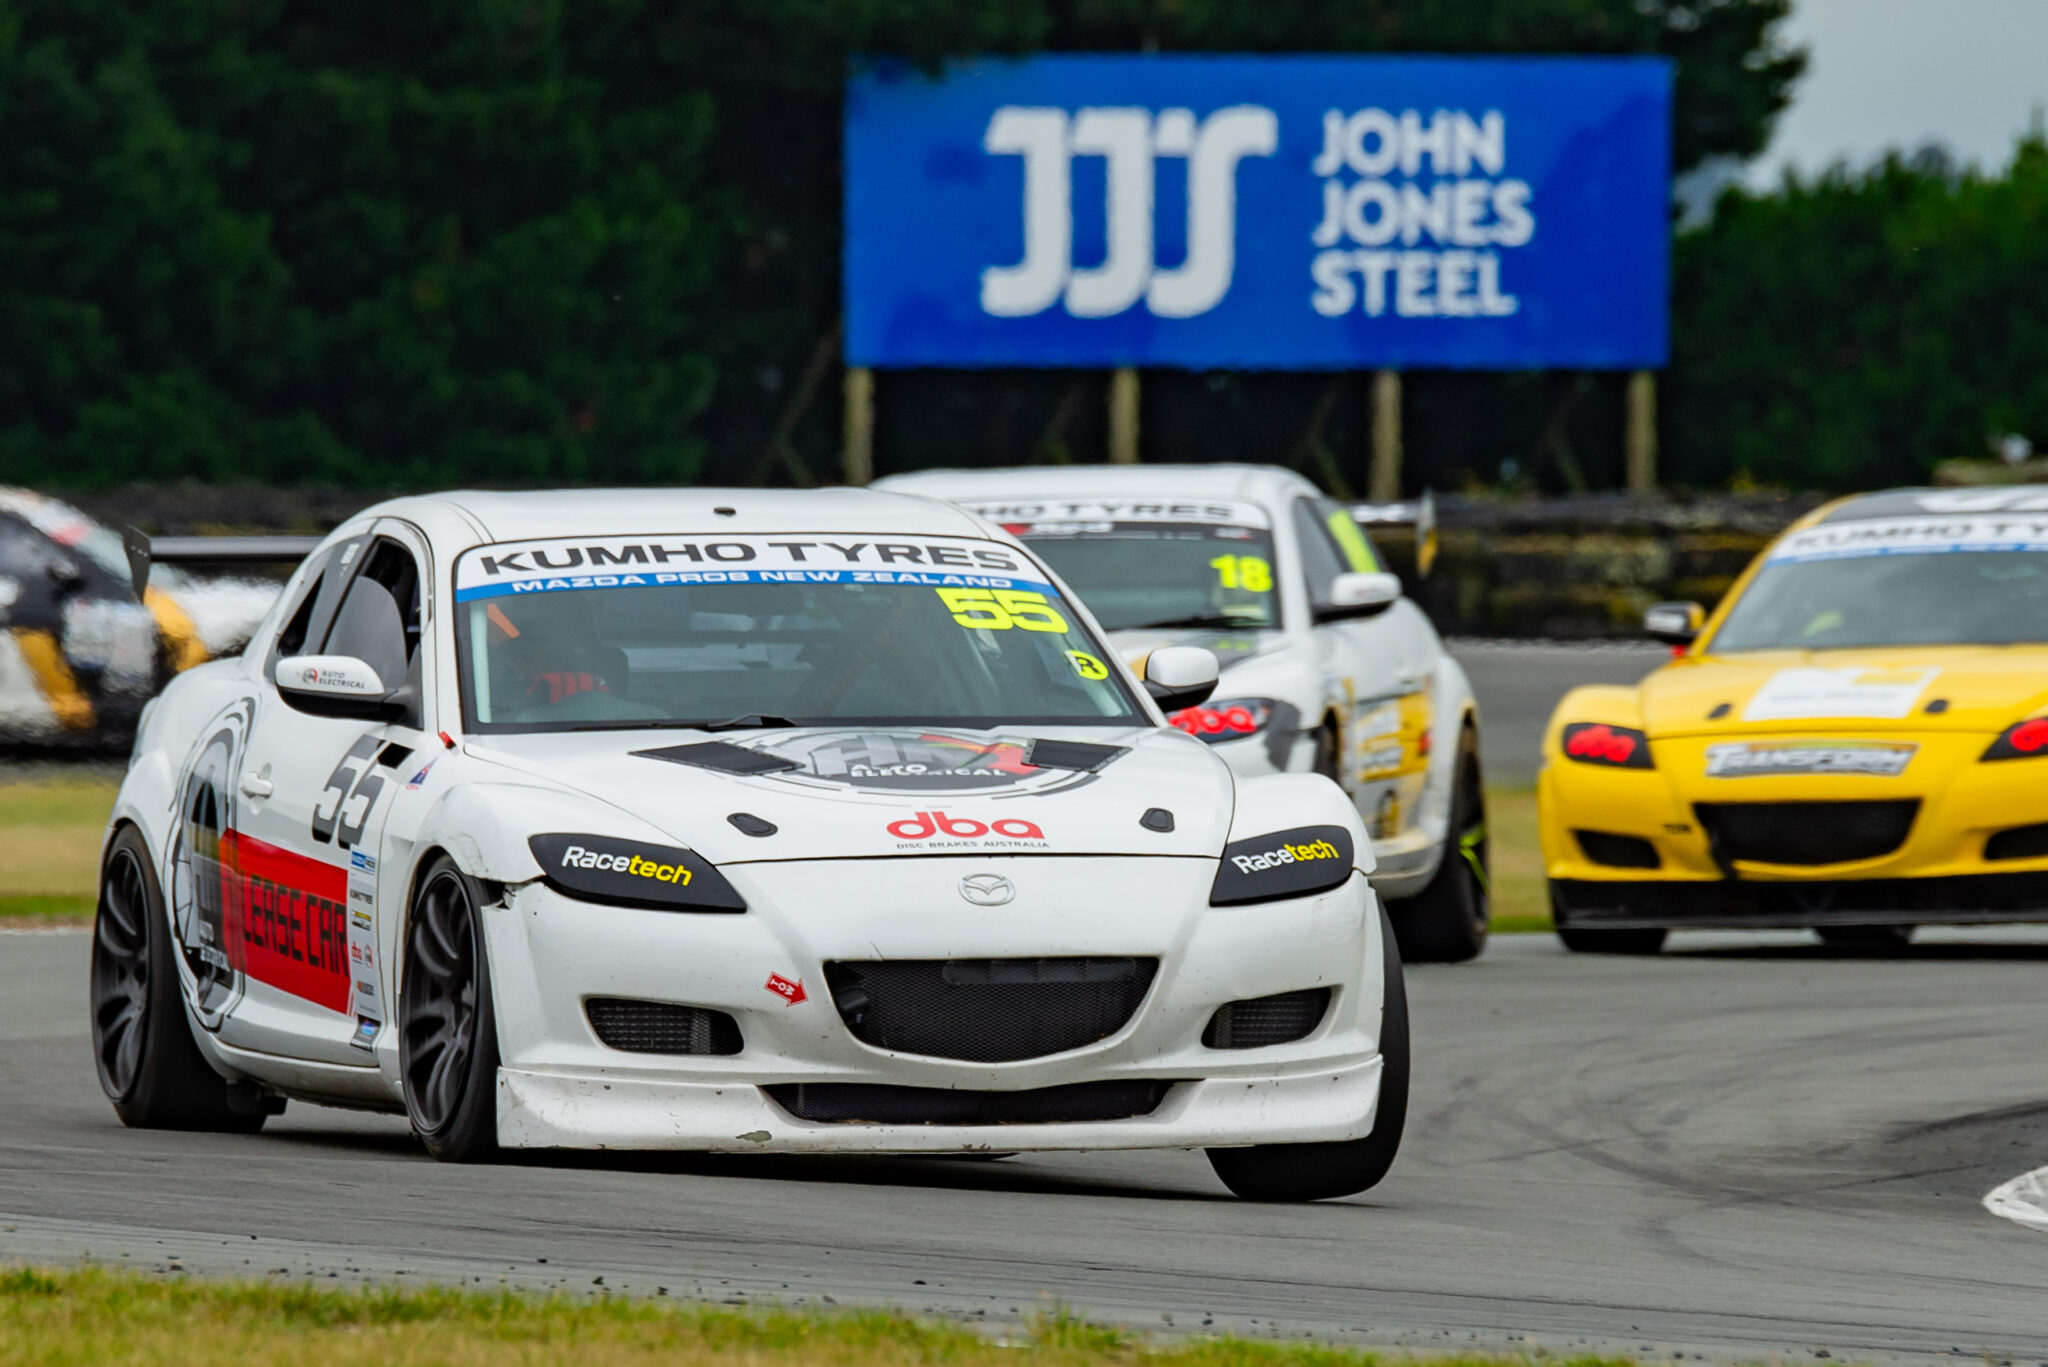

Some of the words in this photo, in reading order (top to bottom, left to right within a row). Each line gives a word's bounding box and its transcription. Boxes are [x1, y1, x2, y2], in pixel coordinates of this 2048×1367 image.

[1312, 108, 1506, 177] JOHN
[1312, 180, 1535, 247] JONES
[1311, 250, 1518, 317] STEEL
[1058, 504, 1232, 519] TYRES
[481, 543, 756, 575] KUMHO
[768, 542, 1018, 571] TYRES
[1209, 554, 1272, 592] 18
[512, 574, 646, 592] MAZDA
[759, 571, 839, 582] NEW
[853, 573, 1012, 588] ZEALAND
[935, 587, 1069, 633] 55
[318, 678, 365, 689] ELECTRICAL
[321, 669, 346, 680] AUTO
[311, 733, 416, 851] 55
[886, 811, 1045, 839] dba
[896, 842, 923, 850] DISC
[929, 841, 978, 849] BRAKES
[984, 841, 1051, 849] AUSTRALIA
[1231, 839, 1339, 874] Racetech
[561, 846, 693, 886] Racetech
[770, 978, 796, 996] TOW
